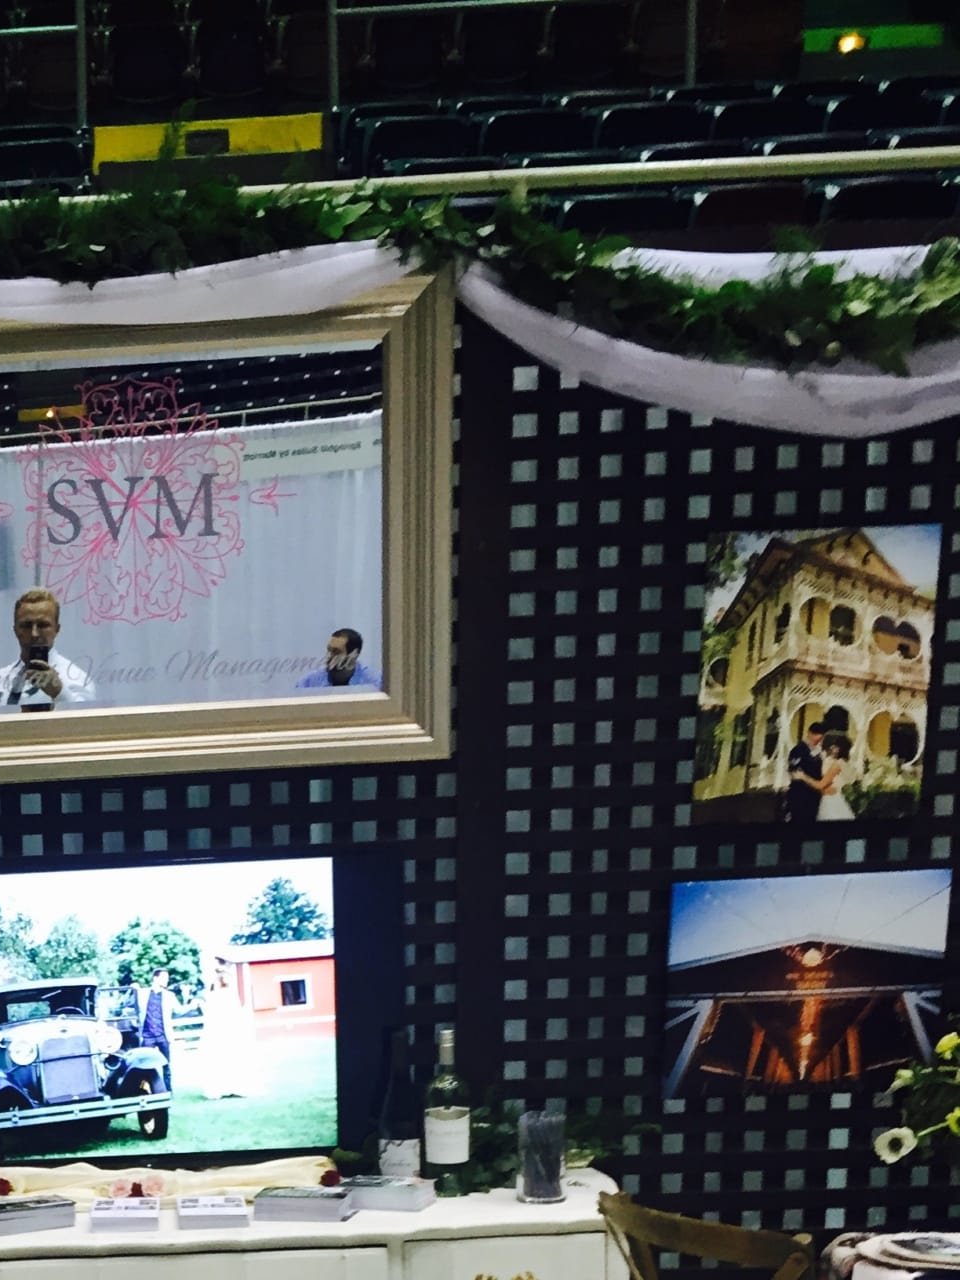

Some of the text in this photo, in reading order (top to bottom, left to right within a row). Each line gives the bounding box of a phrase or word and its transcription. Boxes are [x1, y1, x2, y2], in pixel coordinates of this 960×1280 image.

[47, 472, 221, 545] SVM
[66, 651, 156, 689] Venue
[166, 647, 363, 683] Management
